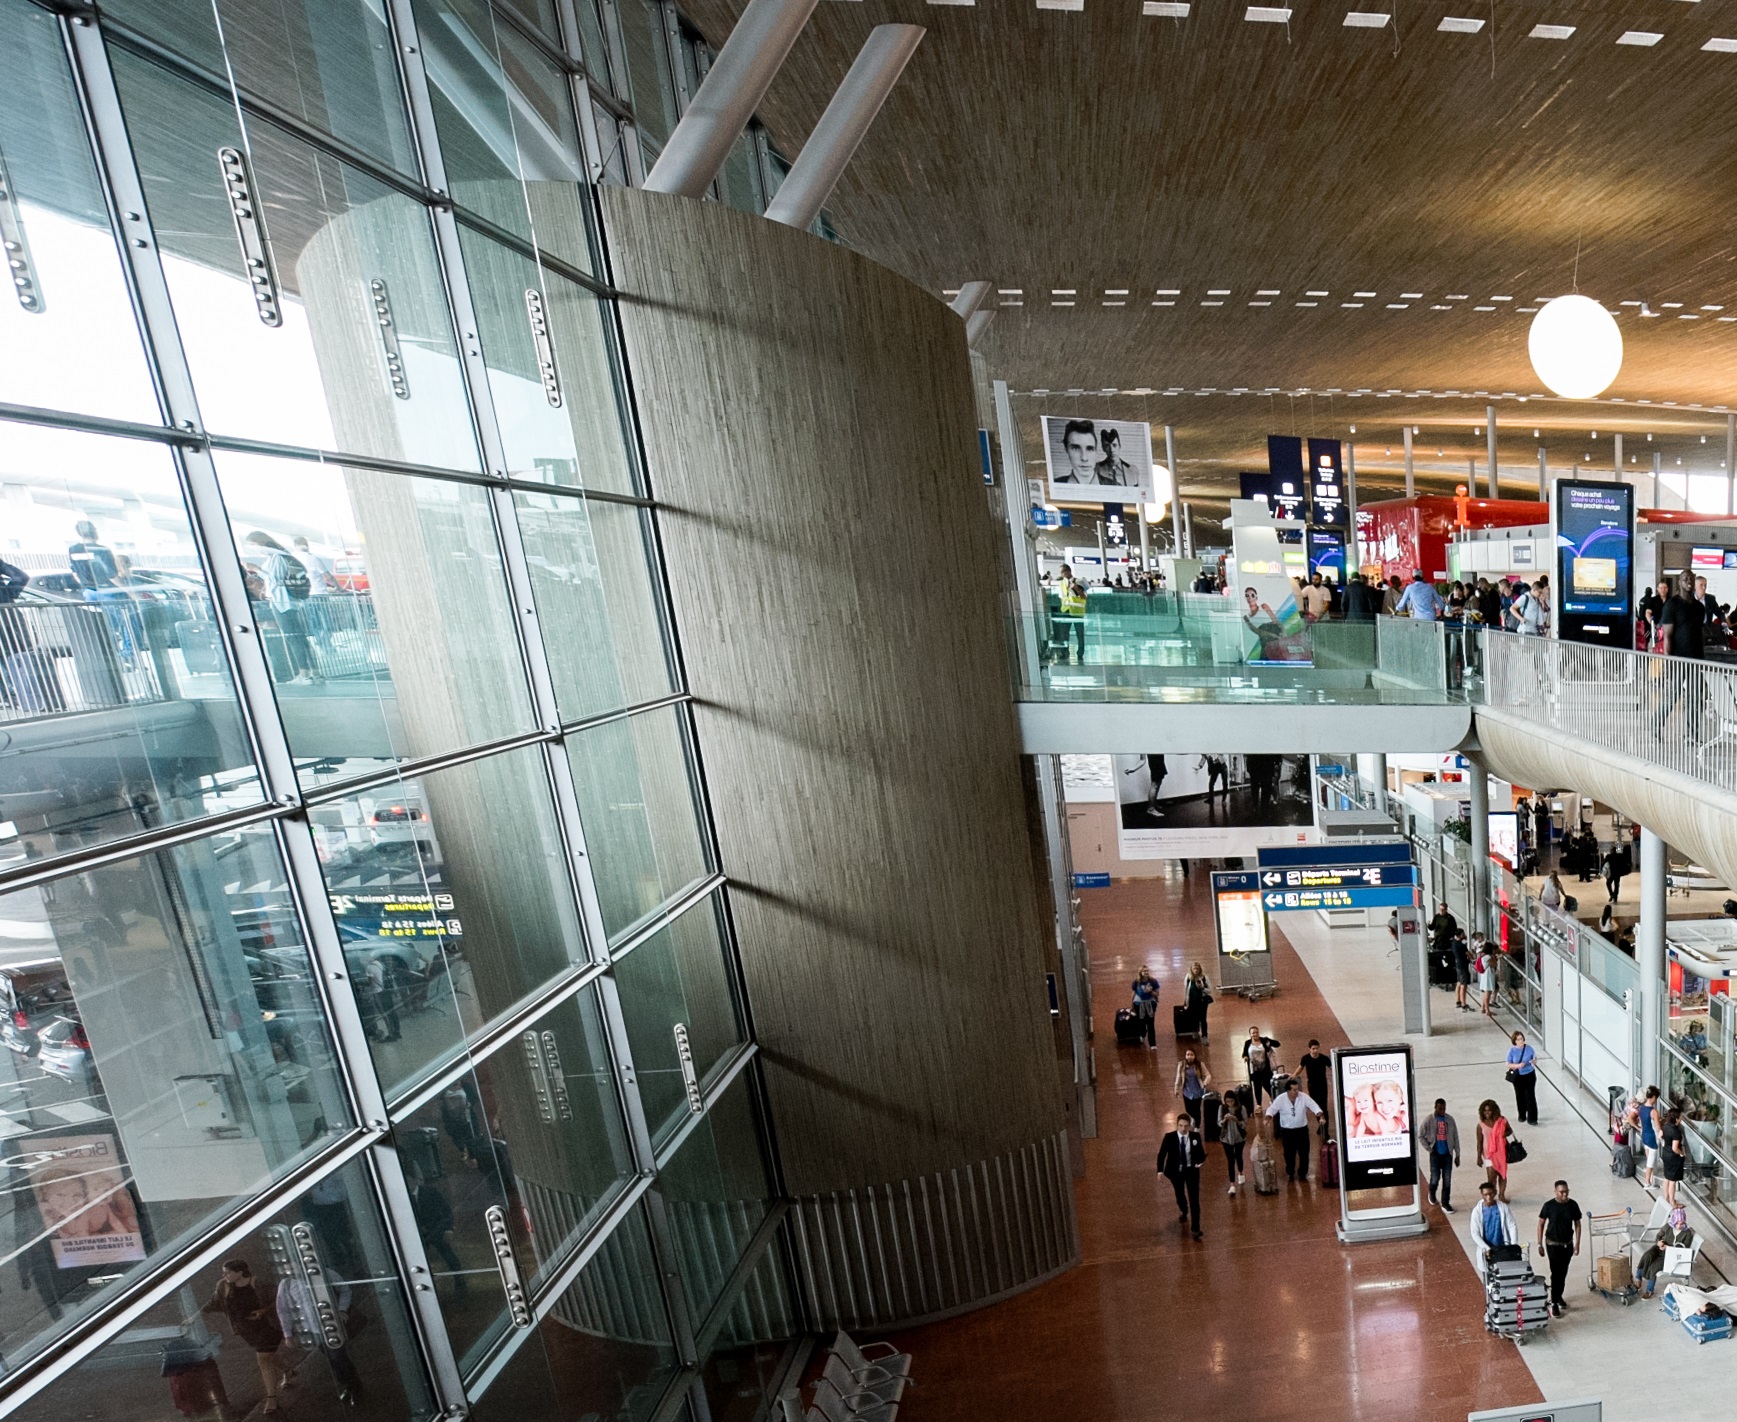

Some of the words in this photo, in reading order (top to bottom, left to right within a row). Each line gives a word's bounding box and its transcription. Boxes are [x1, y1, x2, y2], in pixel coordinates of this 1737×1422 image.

[1302, 878, 1342, 886] Departures
[1363, 868, 1381, 885] 2E
[1348, 1062, 1400, 1075] Biostime
